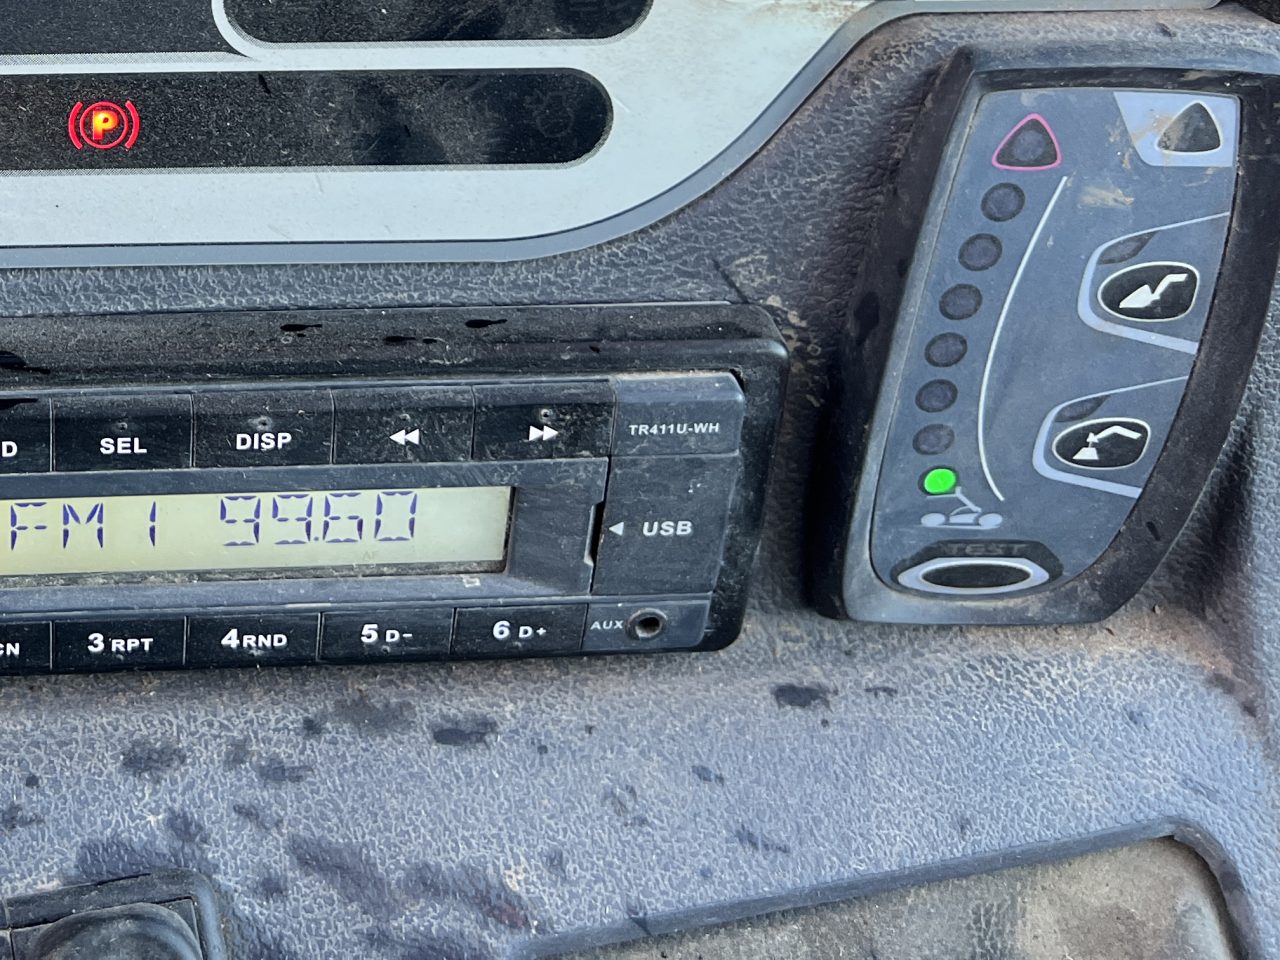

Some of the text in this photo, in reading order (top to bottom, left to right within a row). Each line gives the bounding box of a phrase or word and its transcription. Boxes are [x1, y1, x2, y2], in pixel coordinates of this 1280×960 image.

[628, 421, 721, 437] TR411U-WH
[99, 437, 148, 455] SEL
[235, 431, 292, 451] DISP
[642, 520, 693, 537] USB
[360, 623, 381, 644] 5
[492, 621, 511, 640] 6
[590, 619, 623, 631] AUX
[87, 633, 154, 653] 3 RPT
